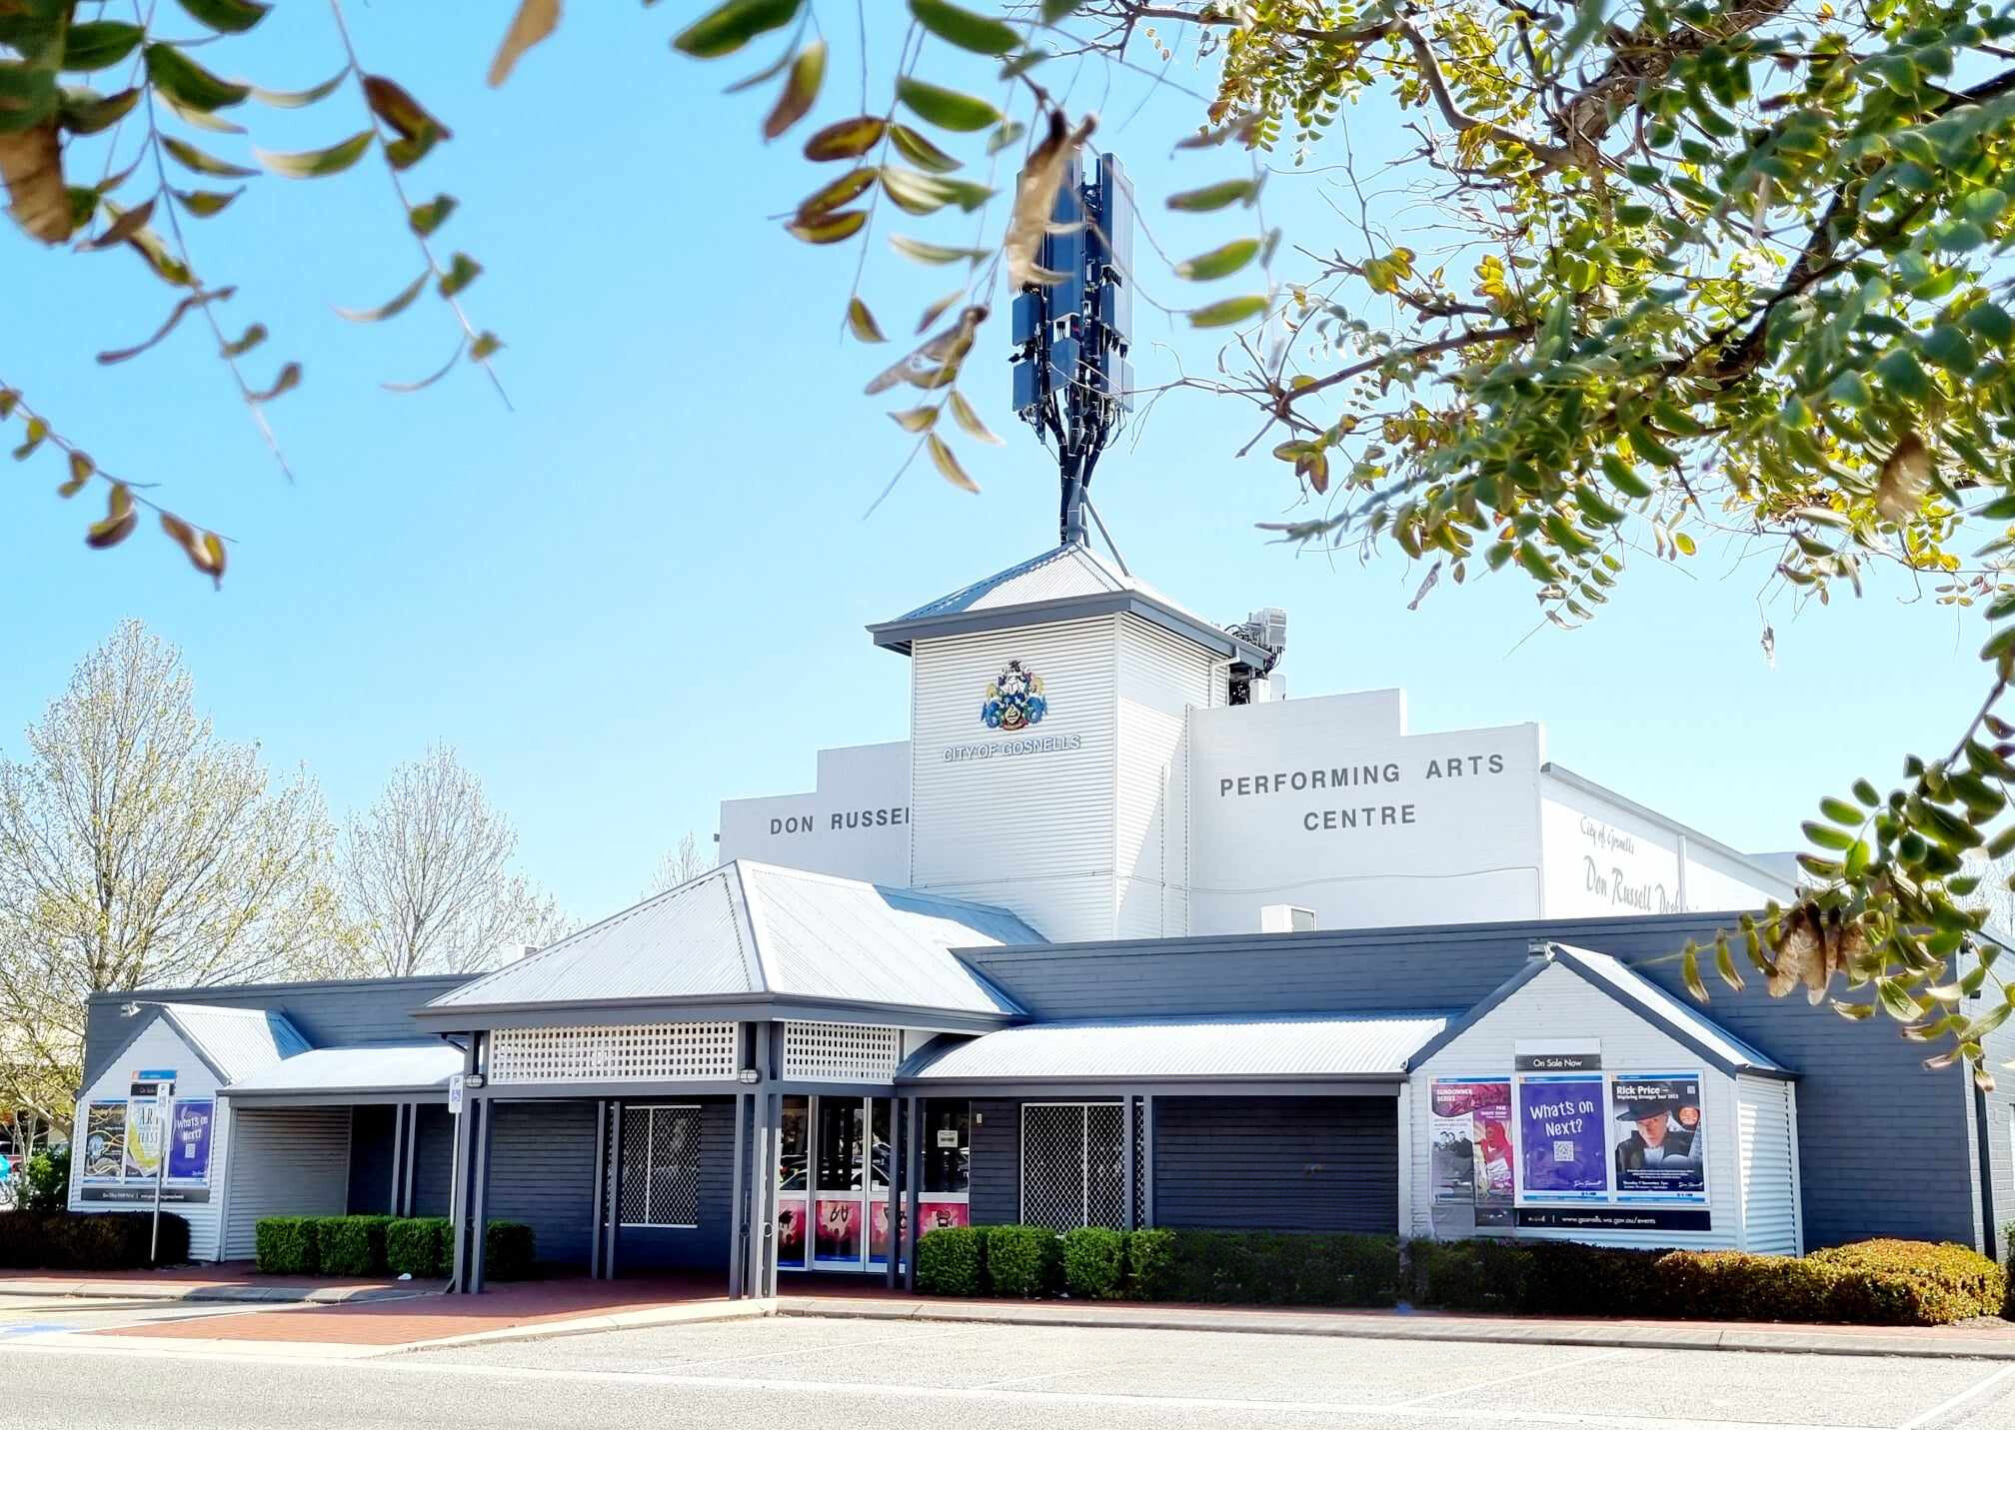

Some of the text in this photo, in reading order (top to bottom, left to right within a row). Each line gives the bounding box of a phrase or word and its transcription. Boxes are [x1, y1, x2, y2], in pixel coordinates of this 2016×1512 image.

[943, 734, 1081, 762] CITY OF GOSNELLS
[1220, 754, 1504, 797] PERFORMING ARTS
[770, 816, 814, 835] DON
[1303, 804, 1416, 831] CENTRE
[1580, 815, 1597, 847] City
[1598, 825, 1606, 848] of
[1583, 855, 1607, 897] Don
[1611, 867, 1652, 911] Russell
[1533, 1058, 1583, 1068] On Sale Now
[1616, 1085, 1660, 1095] Rick Price
[1530, 1100, 1594, 1120] What's on
[182, 1128, 202, 1140] Next?
[1545, 1118, 1583, 1137] Next?
